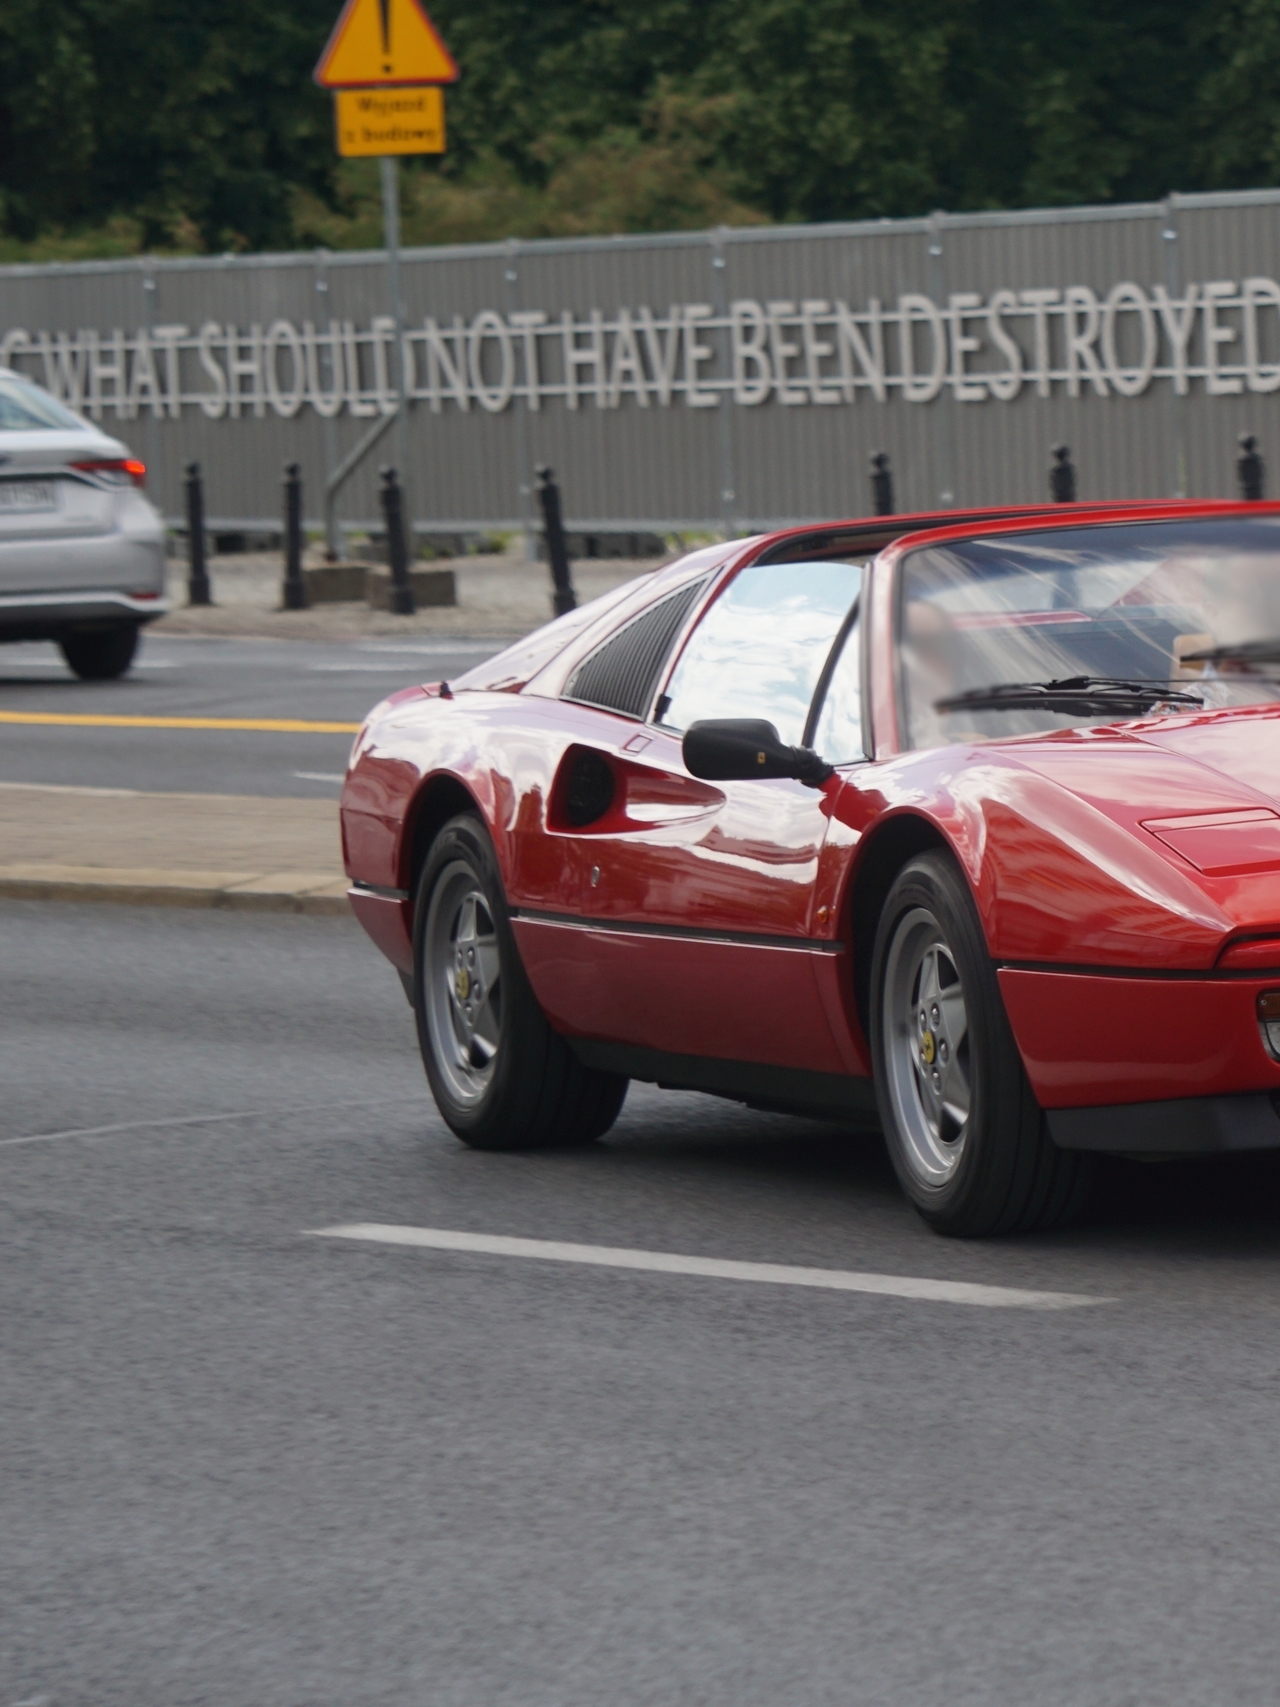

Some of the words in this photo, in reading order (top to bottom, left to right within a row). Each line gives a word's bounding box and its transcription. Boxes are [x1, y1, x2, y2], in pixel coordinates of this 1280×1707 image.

[39, 325, 188, 419] WHAT
[200, 317, 416, 418] SHOULD
[423, 309, 547, 413] NOT
[562, 305, 720, 409] HAVE
[730, 298, 888, 406] BEEN
